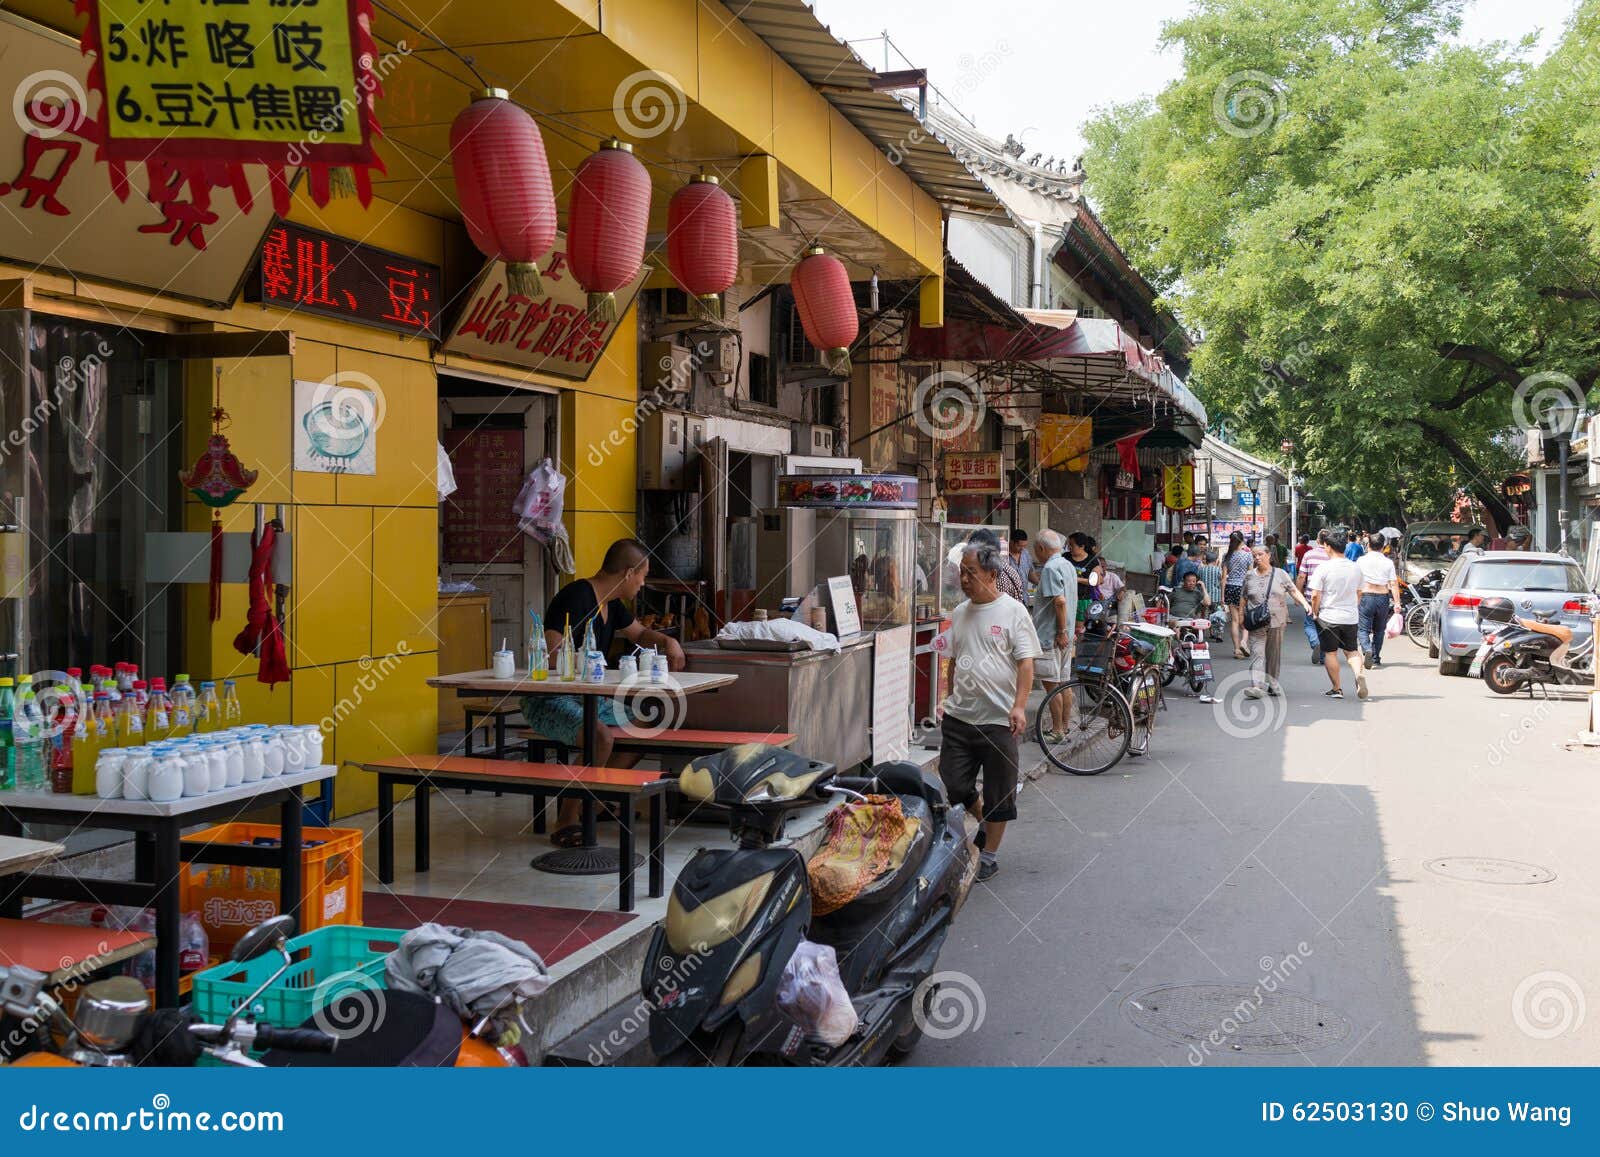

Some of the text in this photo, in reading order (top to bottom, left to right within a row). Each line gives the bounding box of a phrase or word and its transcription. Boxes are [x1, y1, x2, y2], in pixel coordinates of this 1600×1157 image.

[116, 81, 345, 133] 6.豆汁焦圈
[950, 458, 997, 476] 华亚超市
[204, 897, 276, 928] 北冰洋
